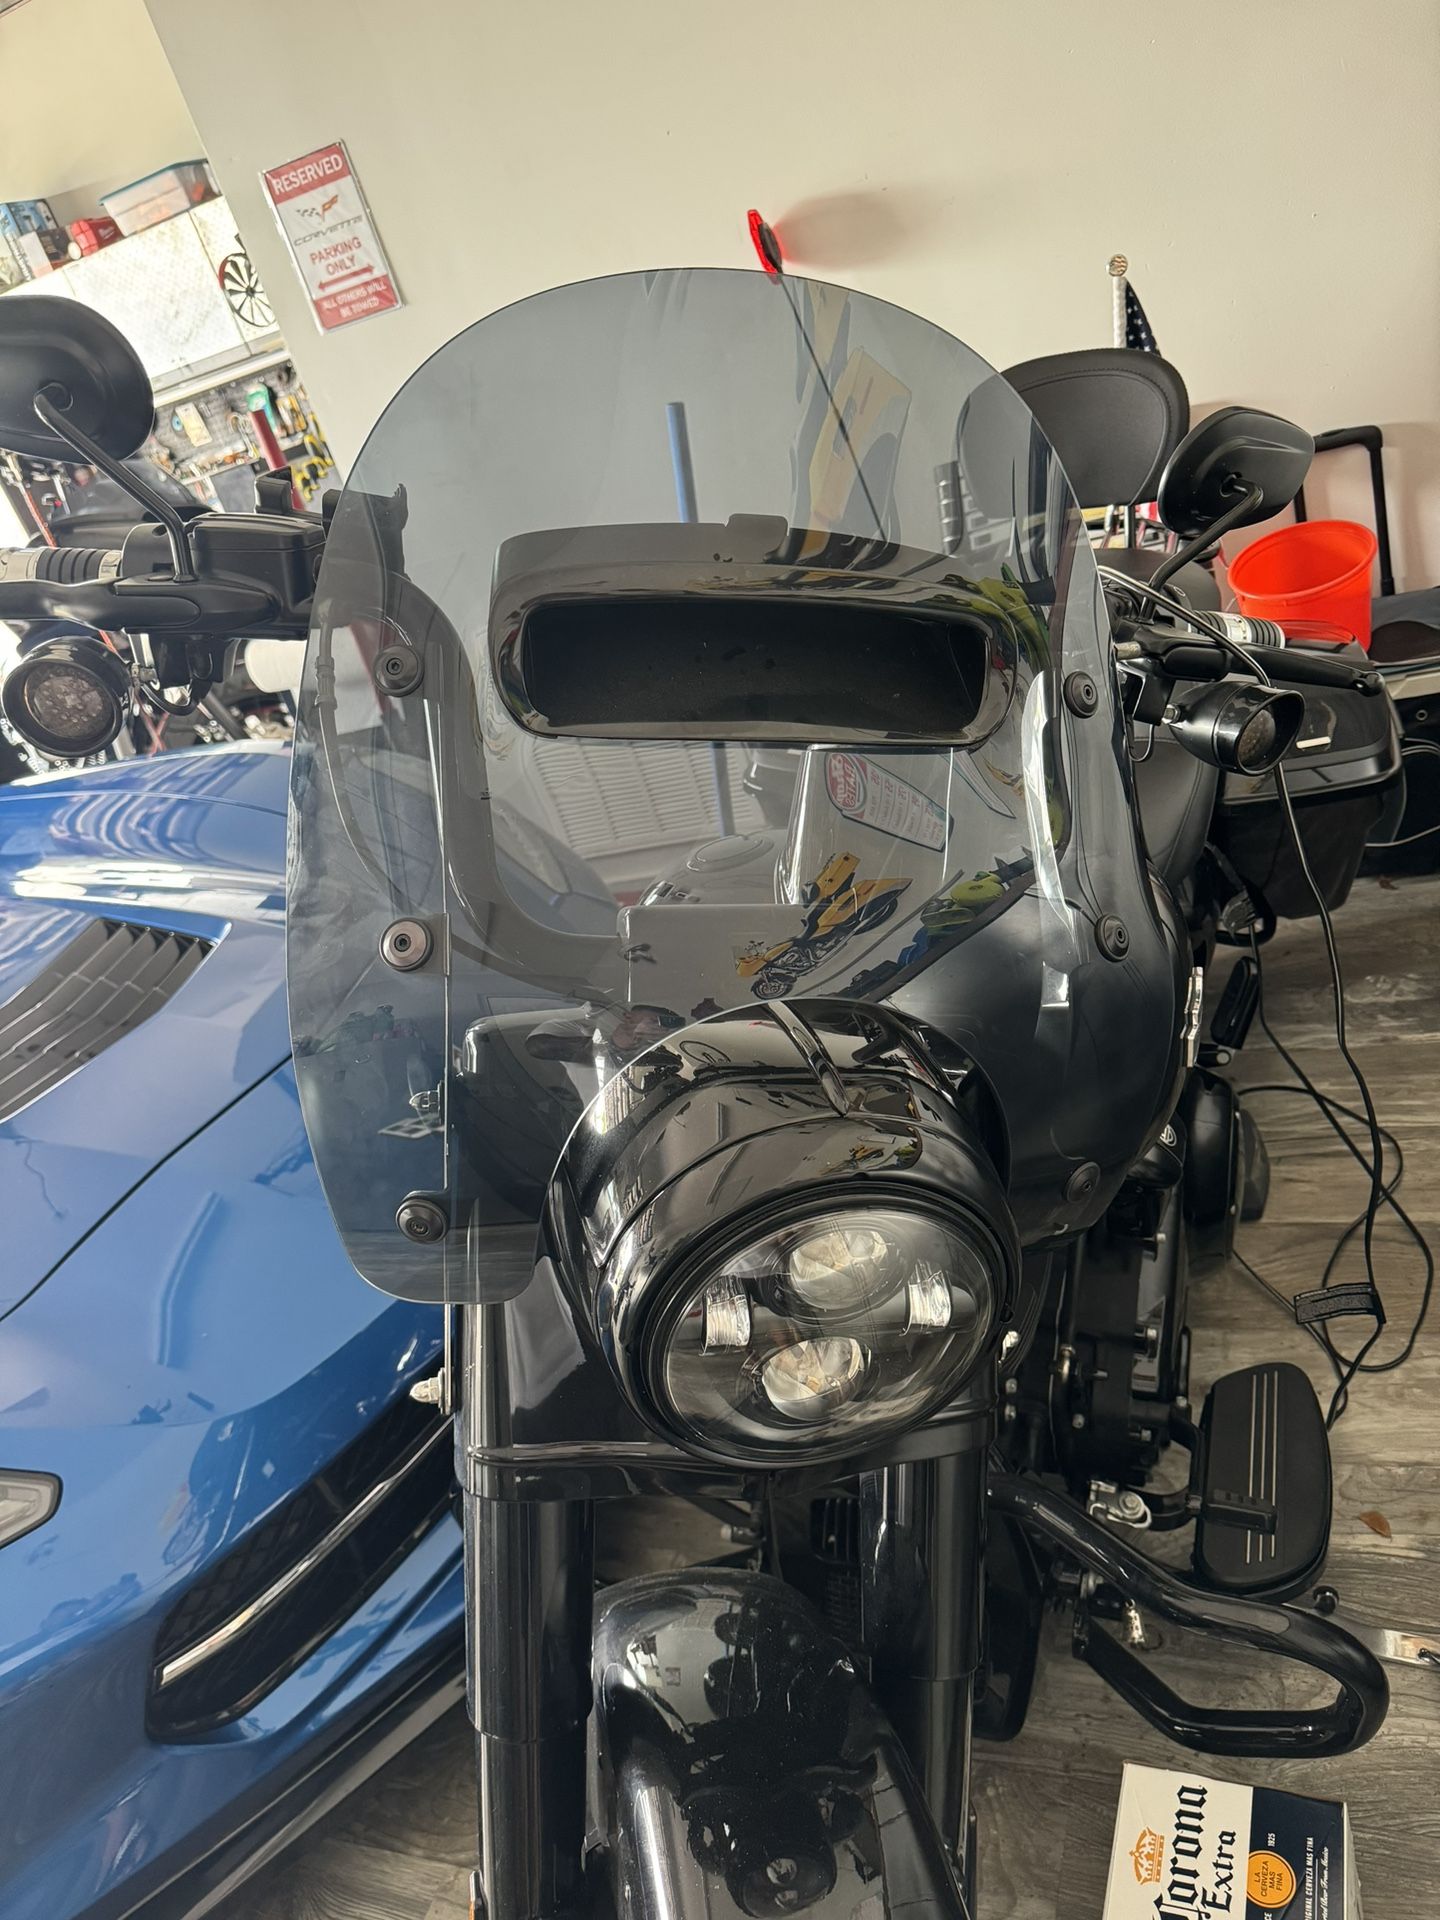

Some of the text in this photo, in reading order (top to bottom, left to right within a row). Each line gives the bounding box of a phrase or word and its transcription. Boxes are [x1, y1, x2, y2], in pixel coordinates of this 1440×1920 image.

[272, 154, 343, 195] RESERVED
[294, 215, 363, 246] CORVETTE
[310, 237, 362, 265] PARKING
[326, 255, 356, 275] ONLY
[1268, 1833, 1276, 1847] 1925
[1306, 1836, 1314, 1852] FINA
[1201, 1831, 1236, 1913] Extra
[1306, 1852, 1314, 1866] MAS
[1254, 1872, 1261, 1883] LA
[1261, 1860, 1269, 1897] CERVEZA
[1305, 1867, 1313, 1896] CERVEZA
